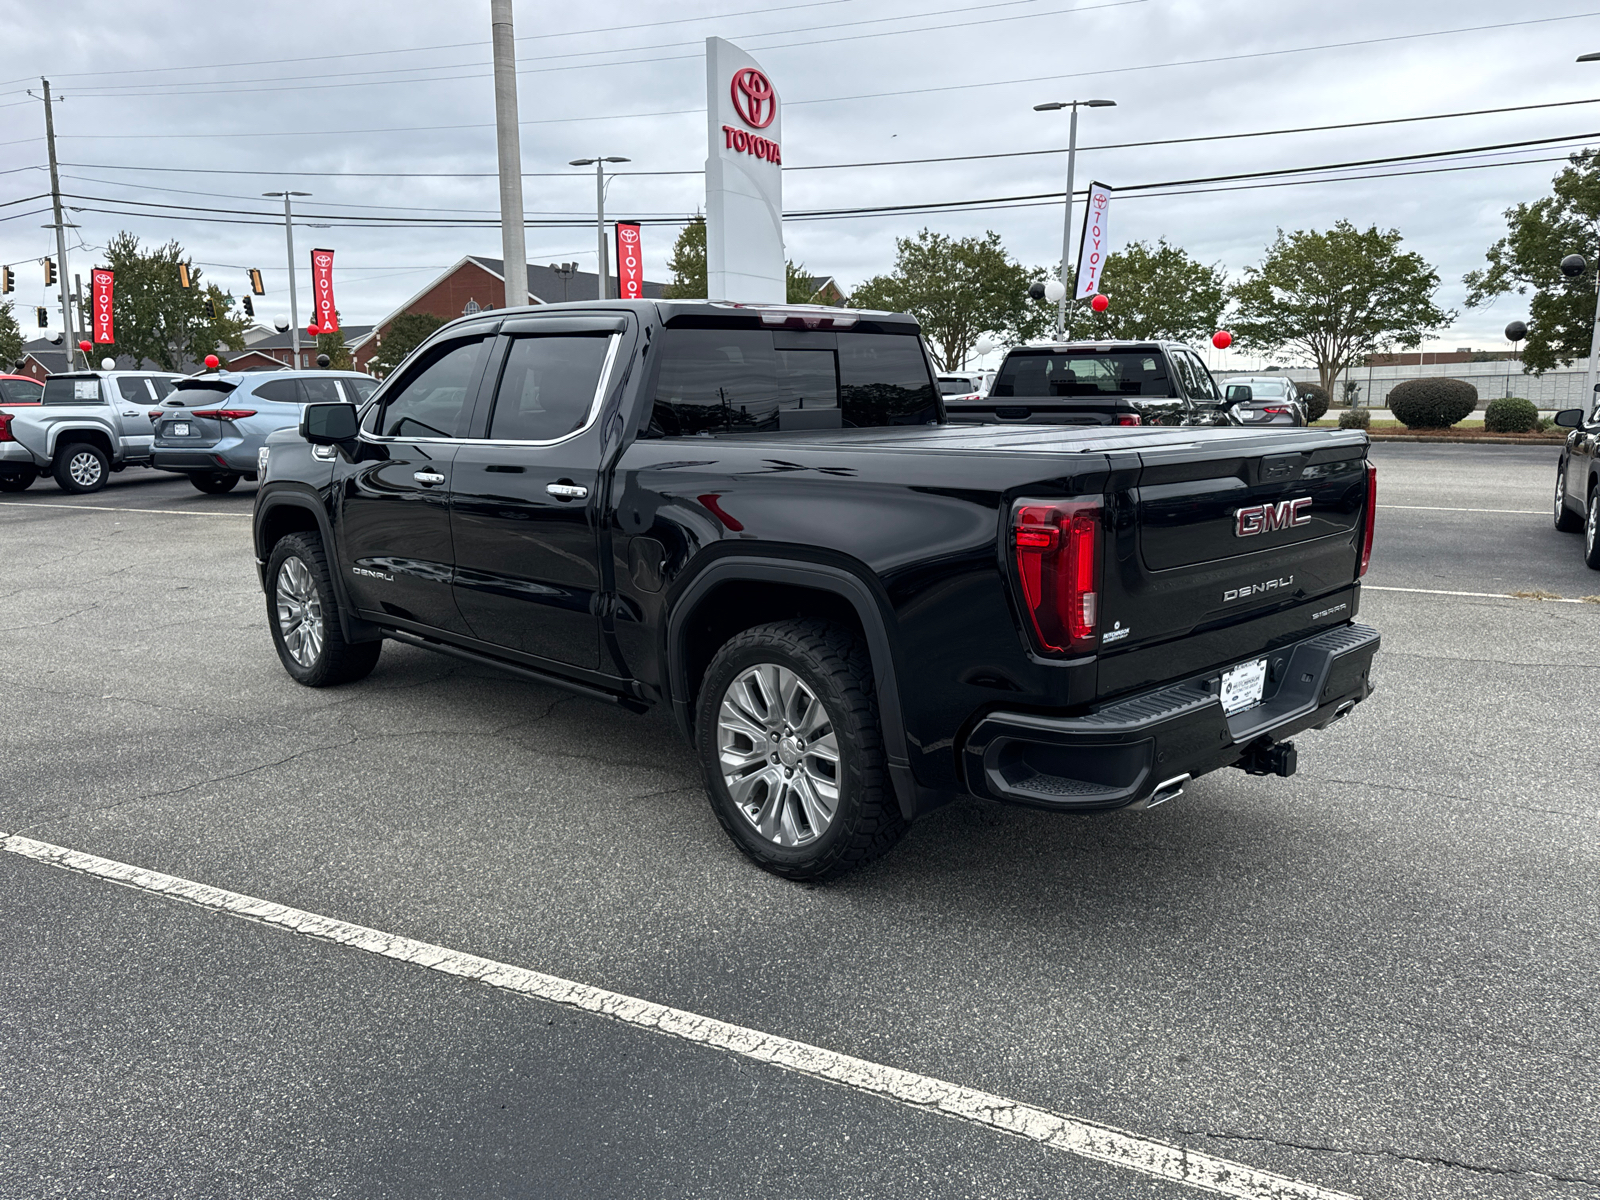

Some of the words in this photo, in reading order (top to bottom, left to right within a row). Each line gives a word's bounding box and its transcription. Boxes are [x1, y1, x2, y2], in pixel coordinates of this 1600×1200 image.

[722, 125, 782, 166] TOYOTA
[625, 244, 638, 299] TOYOT
[1085, 211, 1101, 292] TOYOTA
[99, 285, 109, 340] TOYOTA
[319, 268, 333, 330] TOYOTA
[1234, 496, 1312, 538] GMC
[352, 567, 394, 582] DENALI
[1222, 574, 1294, 602] DENALI
[1311, 602, 1347, 620] SIERRA
